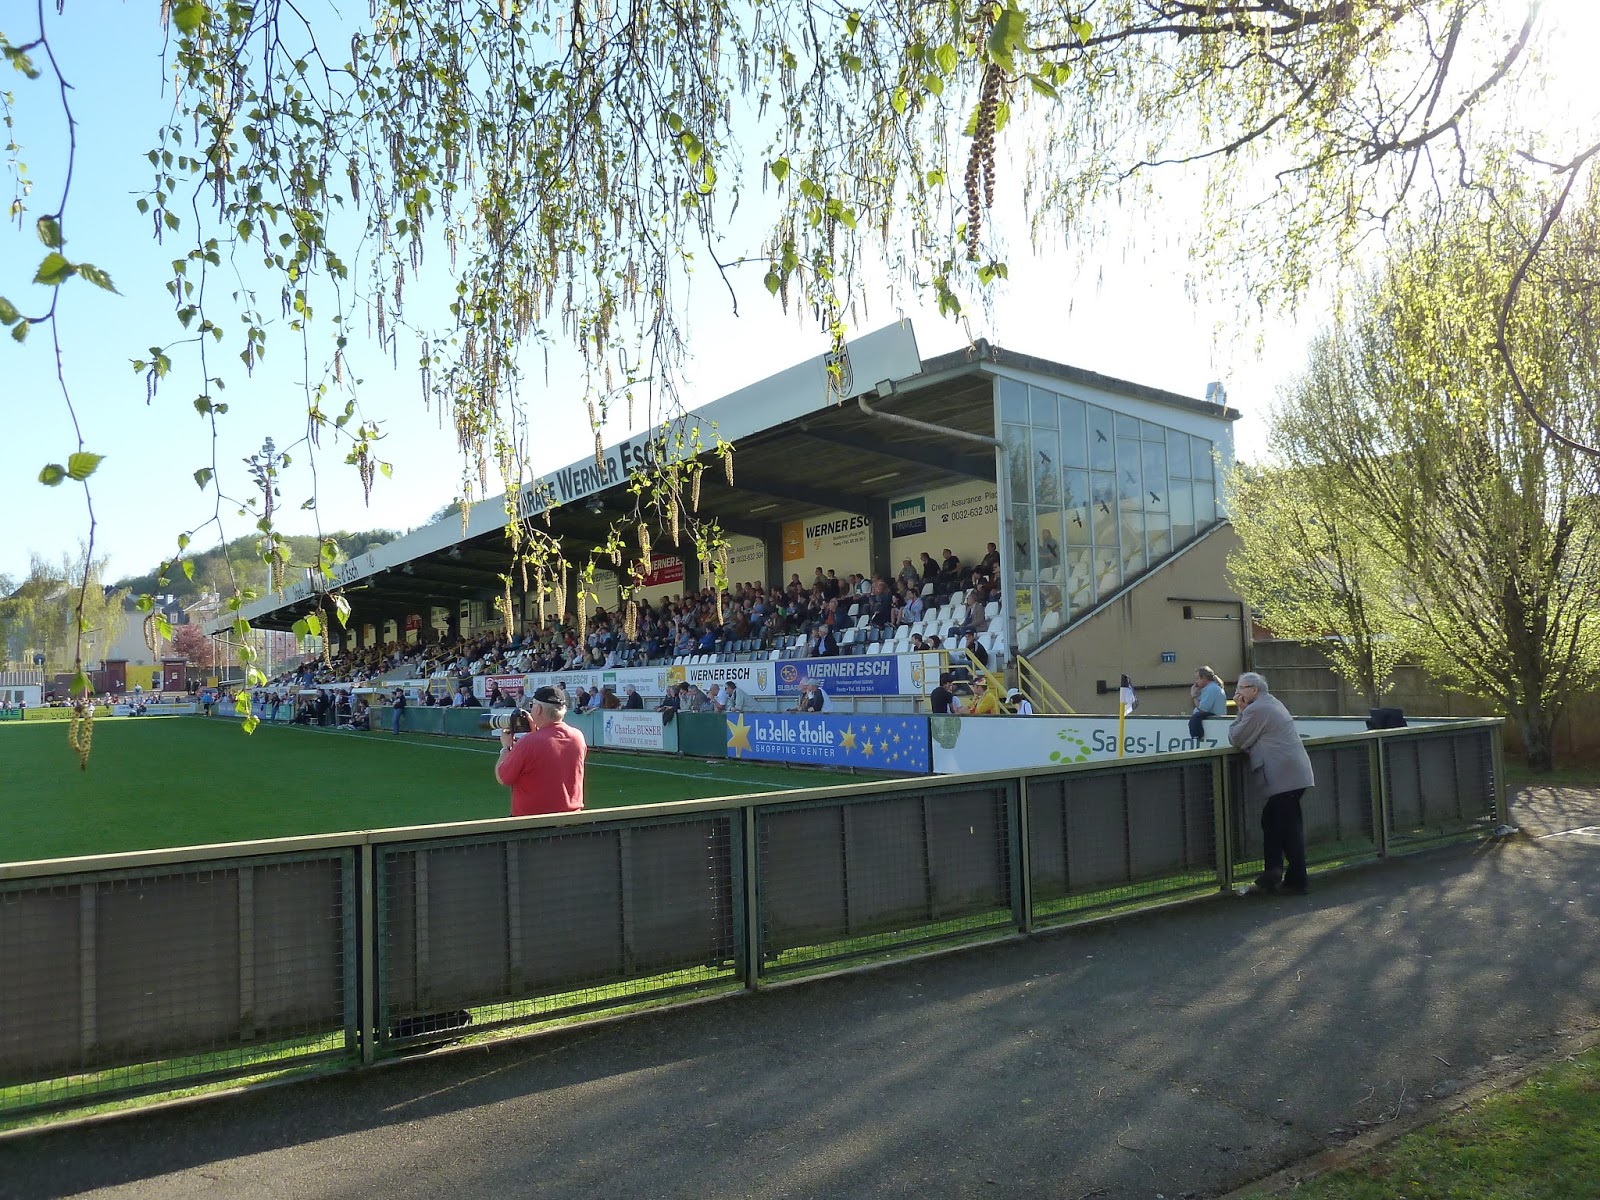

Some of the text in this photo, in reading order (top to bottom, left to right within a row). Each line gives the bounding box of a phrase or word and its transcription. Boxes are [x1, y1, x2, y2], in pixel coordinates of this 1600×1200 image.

[556, 456, 618, 500] WERNER
[931, 502, 949, 512] Credit
[951, 495, 982, 508] Assurance
[951, 504, 998, 521] 0032-632 304
[806, 515, 870, 539] WERNER ESC
[690, 667, 750, 681] WERNER ESCH
[806, 660, 890, 678] WERNER ESCH
[615, 724, 661, 736] Charles BUSSER
[1092, 728, 1218, 754] Saes-Lenz
[755, 744, 835, 757] SHOPPING CENTER
